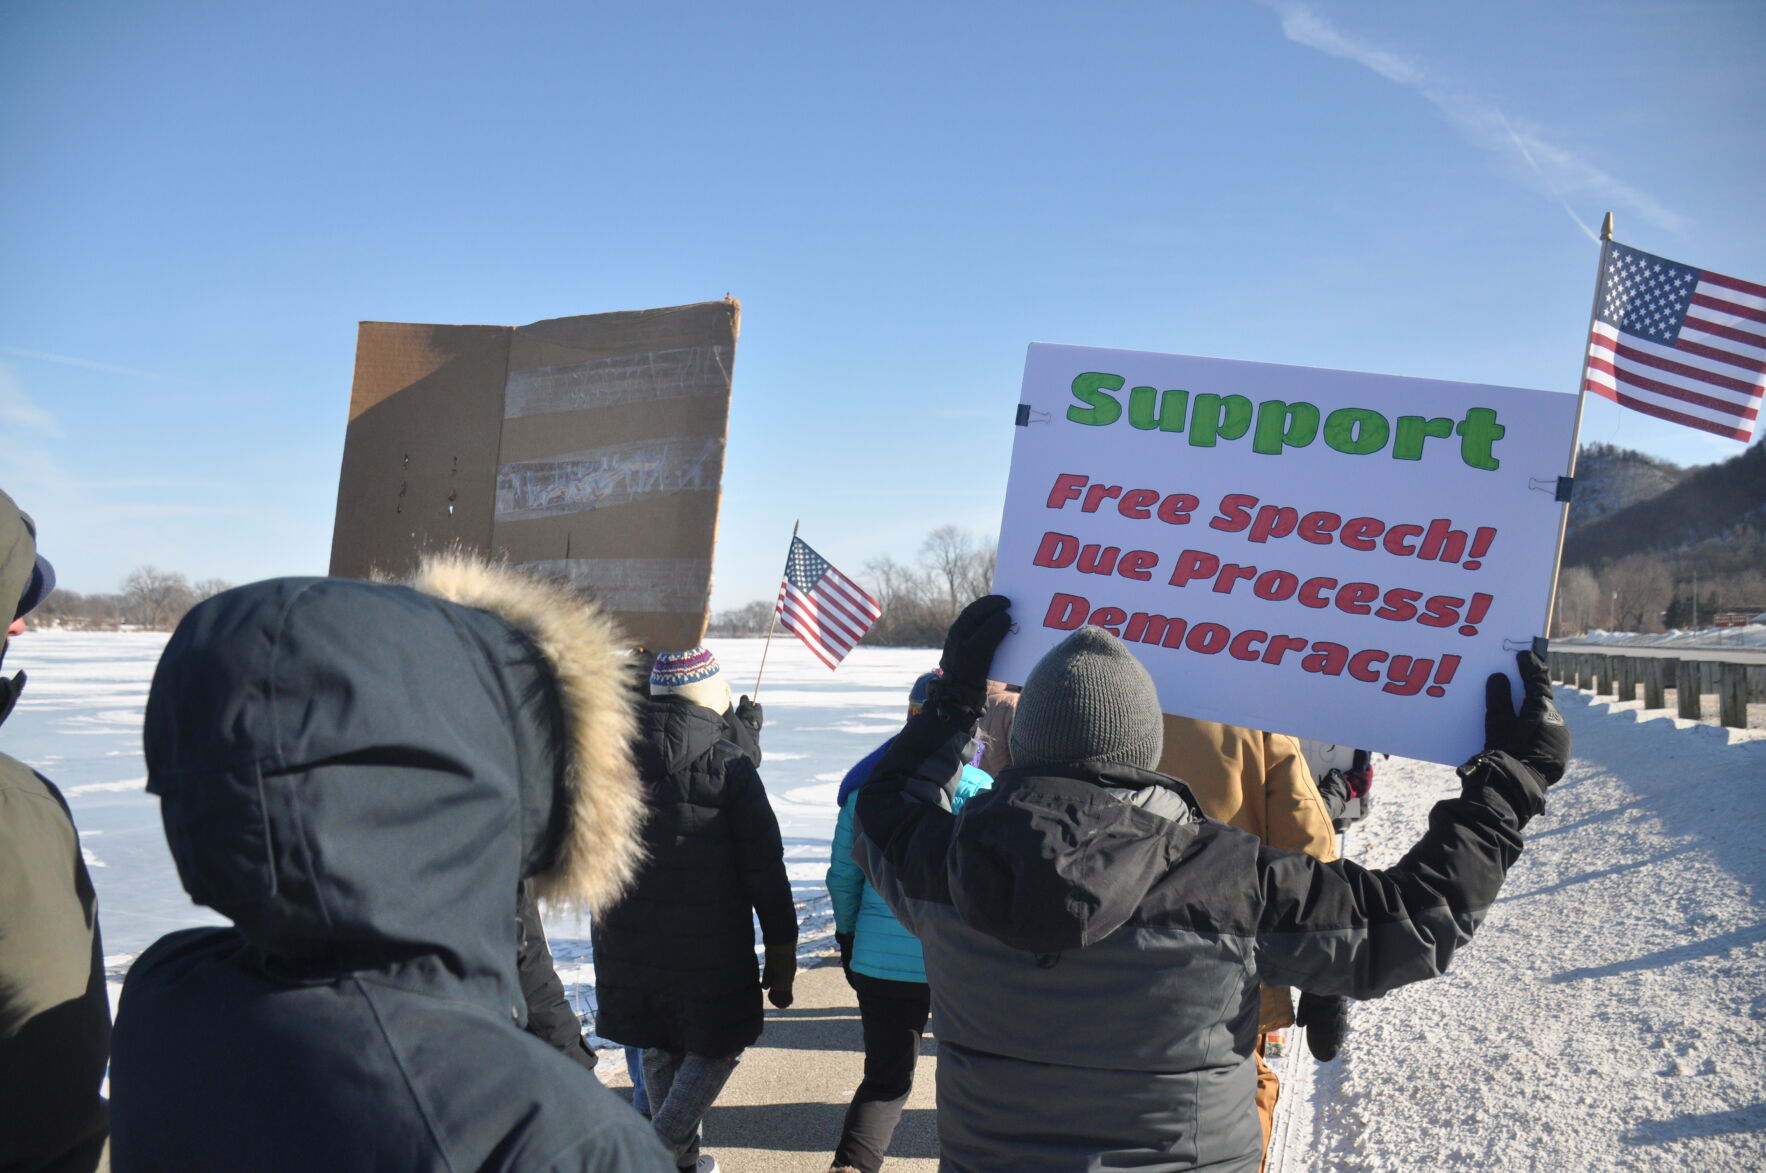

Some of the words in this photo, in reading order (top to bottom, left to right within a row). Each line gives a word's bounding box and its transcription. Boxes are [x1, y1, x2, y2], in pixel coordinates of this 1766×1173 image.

[1066, 371, 1505, 471] Support
[1046, 473, 1200, 525] Free
[1209, 493, 1497, 571] Speech!
[1033, 532, 1159, 581] Due
[1168, 549, 1493, 637] Process!
[1043, 592, 1461, 698] Democracy!
